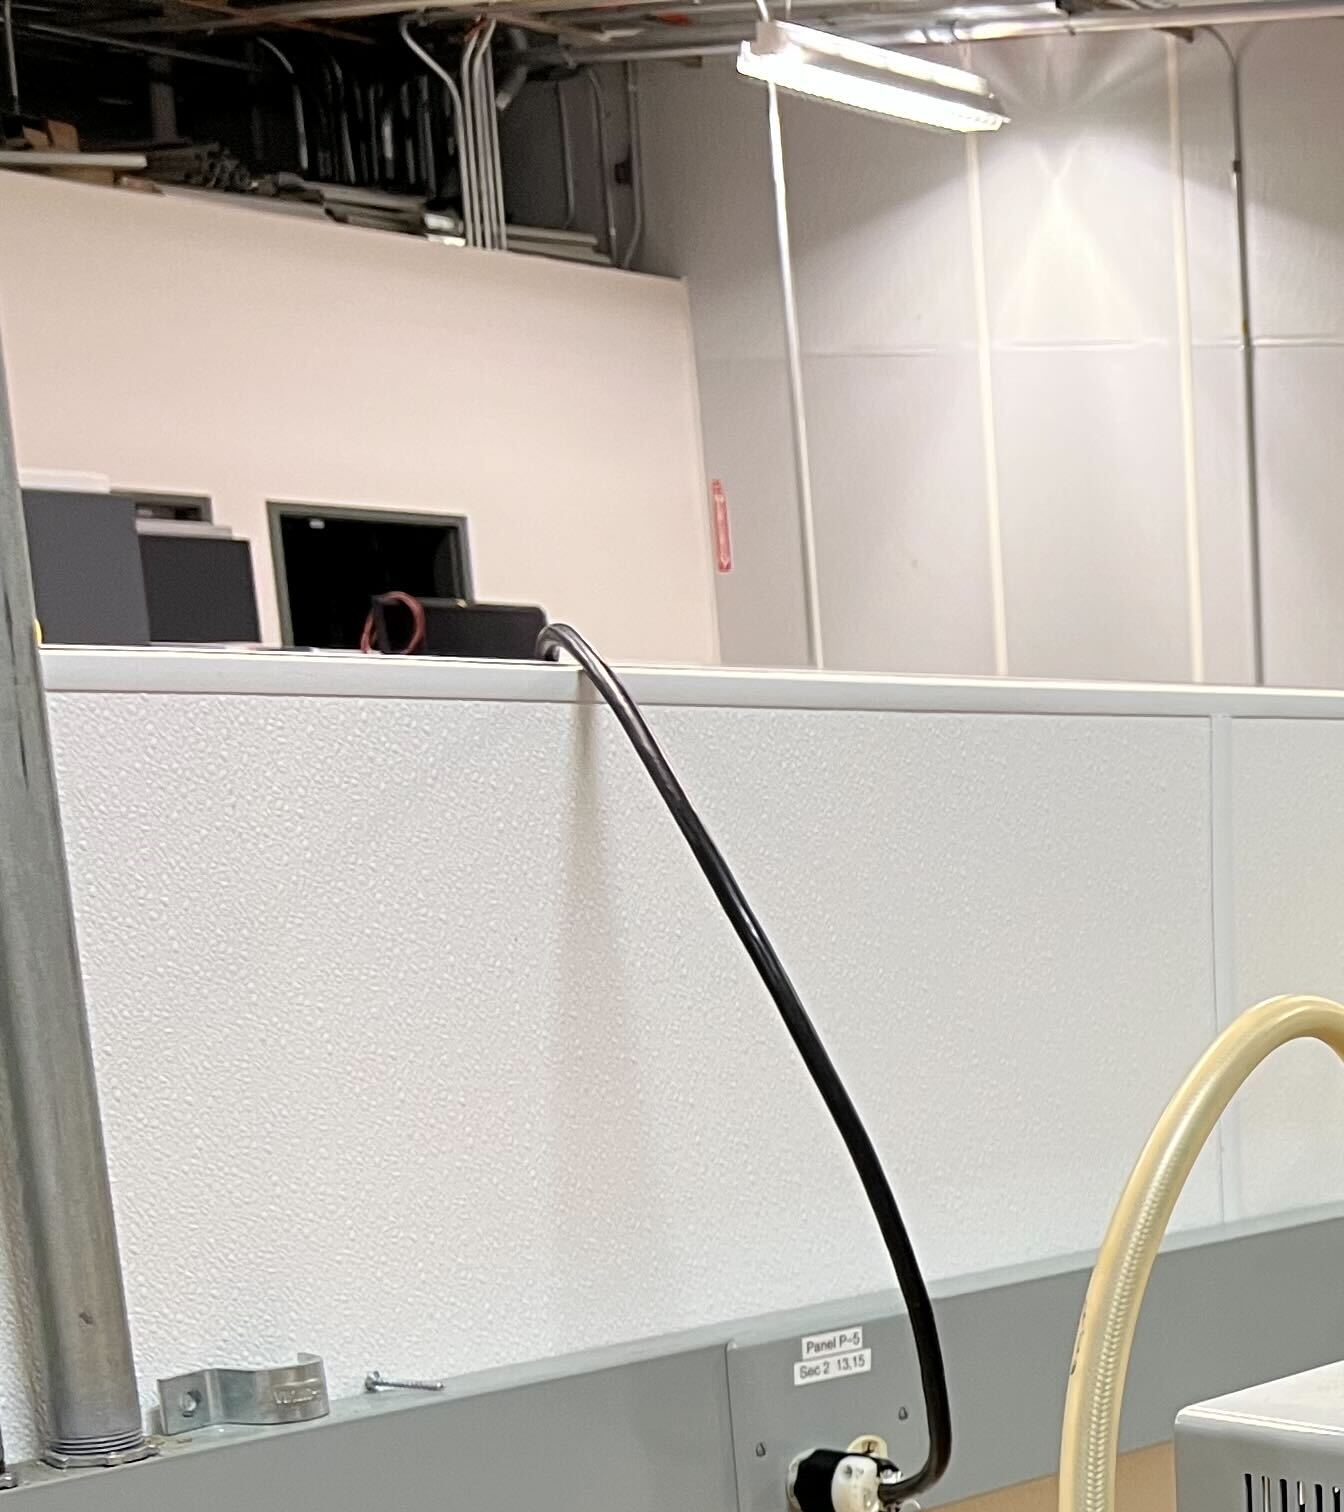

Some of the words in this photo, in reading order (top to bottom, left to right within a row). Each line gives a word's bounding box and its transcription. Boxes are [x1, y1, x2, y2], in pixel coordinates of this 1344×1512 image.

[806, 1337, 837, 1354] Panel
[839, 1331, 861, 1348] P-5
[799, 1365, 821, 1379] Sec
[823, 1361, 830, 1375] 2
